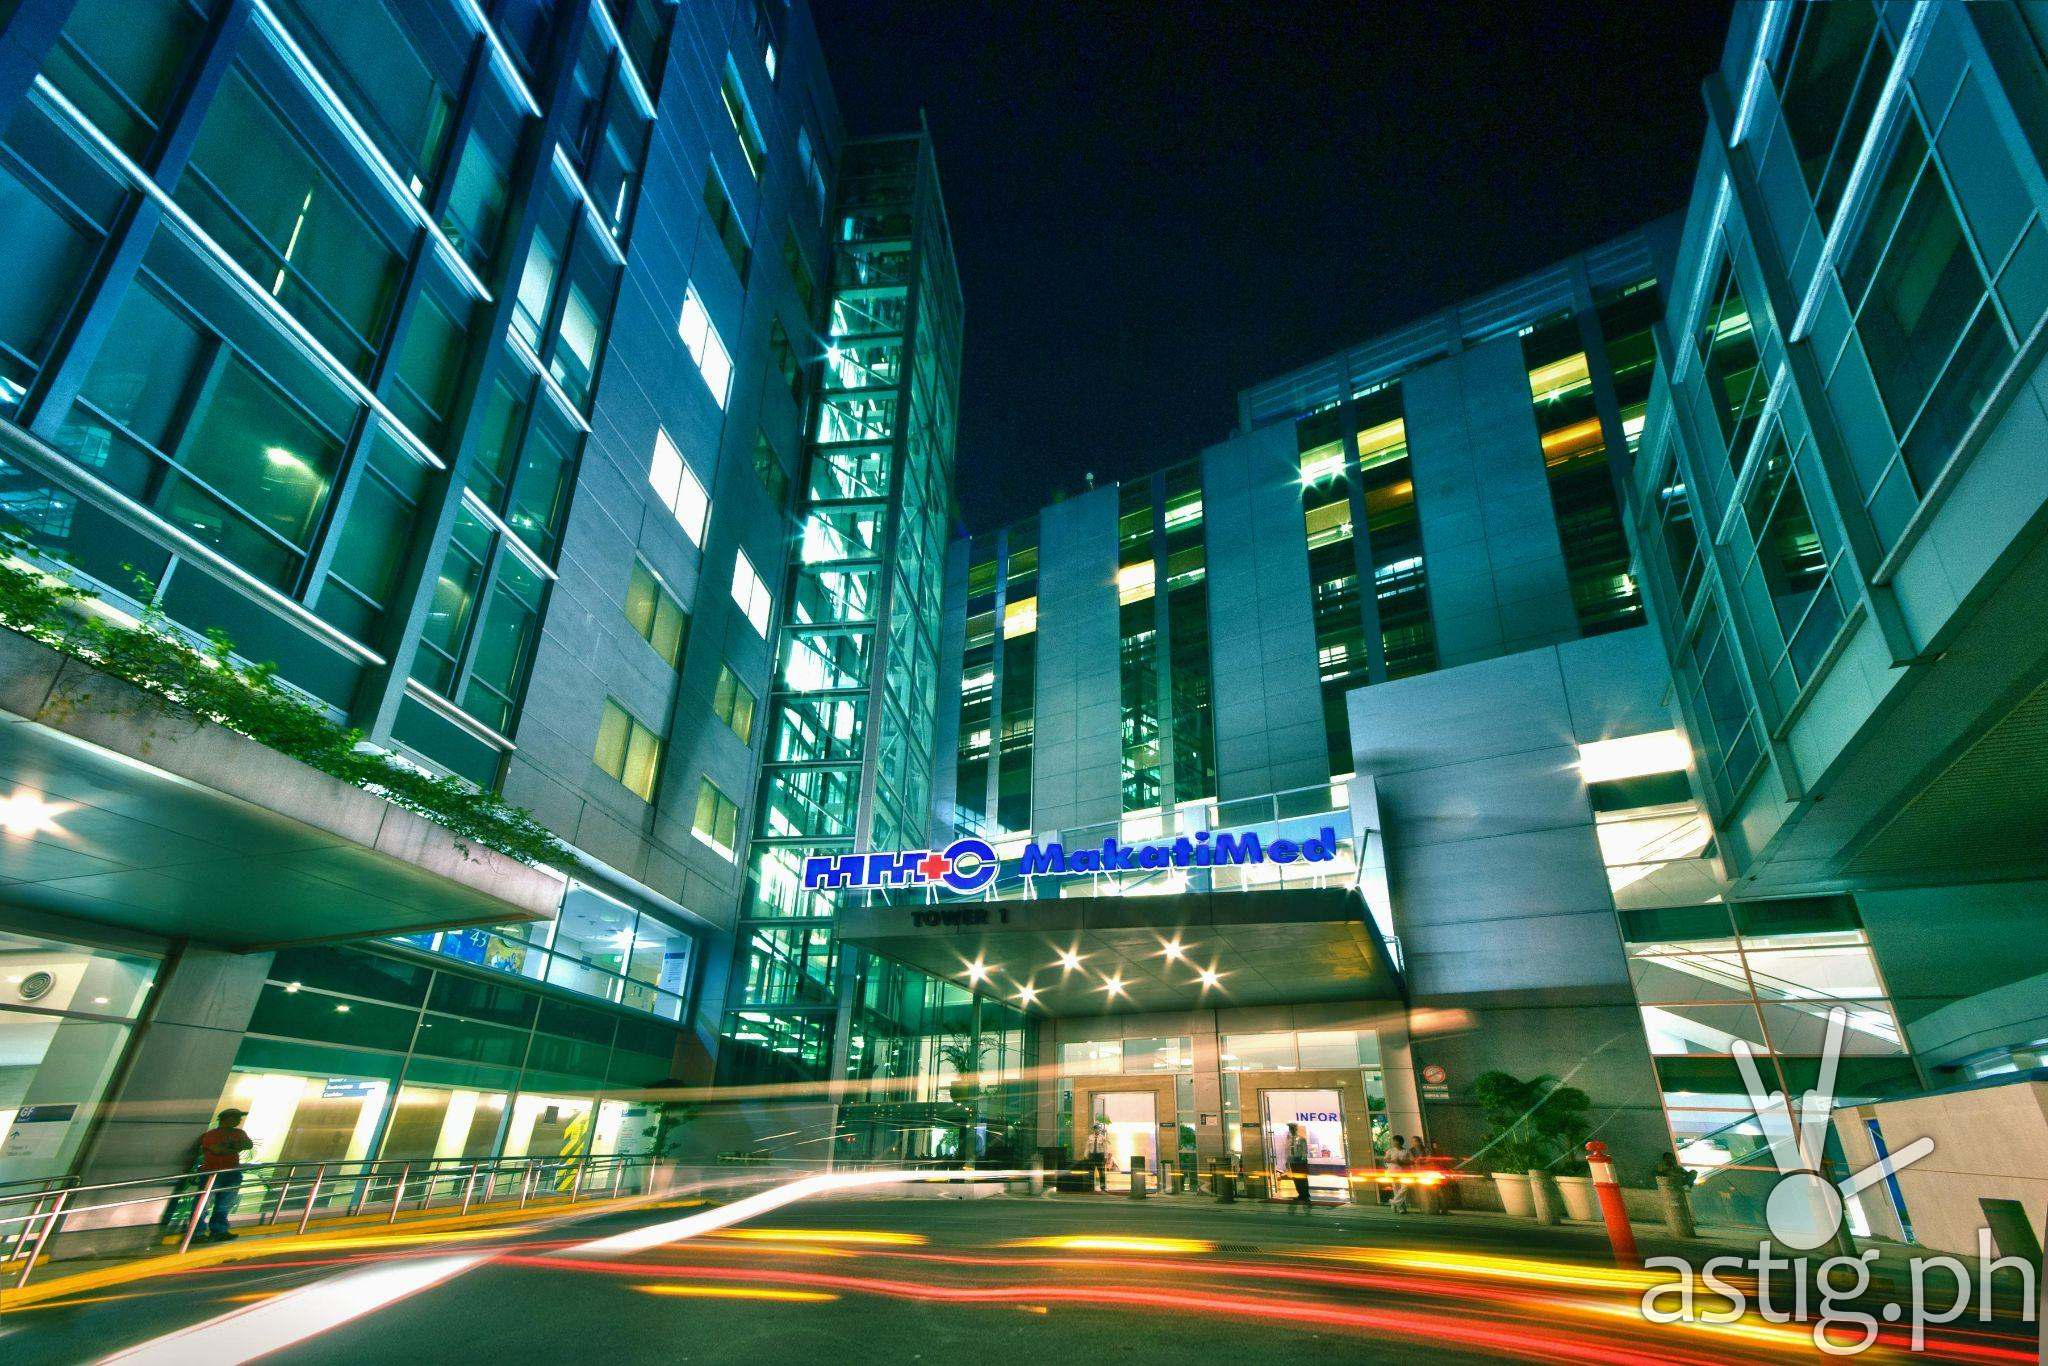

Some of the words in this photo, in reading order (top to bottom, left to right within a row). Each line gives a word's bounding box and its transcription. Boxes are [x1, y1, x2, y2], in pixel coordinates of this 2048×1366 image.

[1018, 826, 1337, 876] MakatiMed
[911, 908, 989, 927] TOWER
[998, 908, 1009, 925] 1
